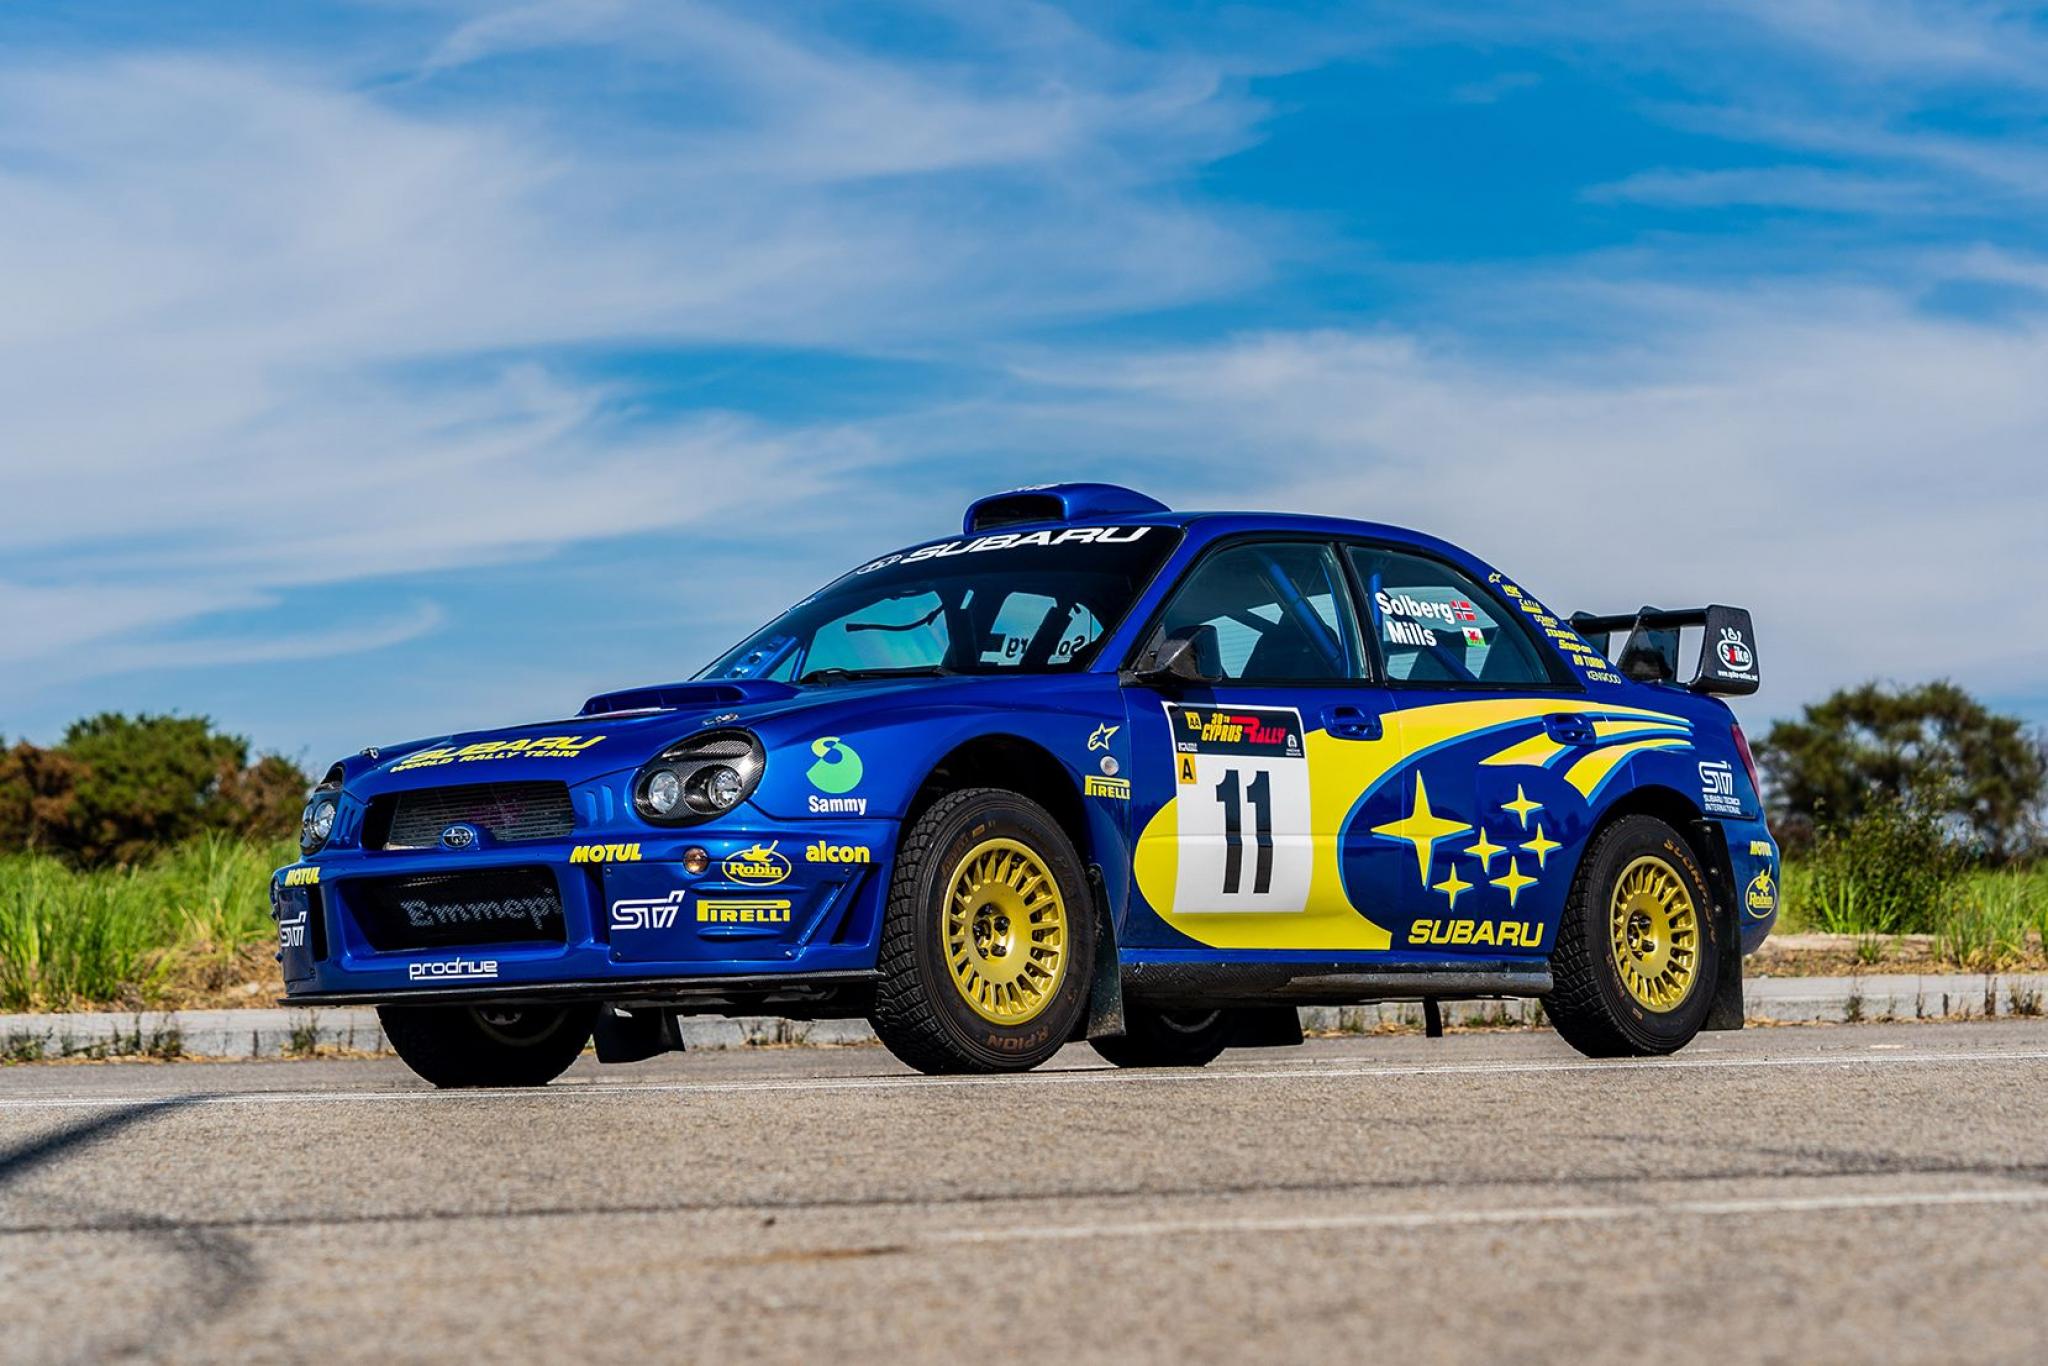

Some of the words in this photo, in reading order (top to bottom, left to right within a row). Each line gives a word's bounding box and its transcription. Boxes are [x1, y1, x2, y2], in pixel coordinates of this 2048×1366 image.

[900, 527, 1151, 565] SUBARU
[1375, 592, 1455, 625] Solberg
[1386, 620, 1437, 647] Mills
[1201, 723, 1243, 742] CYPRUS
[1231, 716, 1286, 744] RALLY
[401, 736, 607, 766] SUBARU
[458, 751, 521, 762] RALLY
[523, 750, 580, 758] TEAM
[1182, 758, 1193, 780] A
[1085, 775, 1131, 799] PIRELLI
[808, 795, 867, 816] Sammy
[1215, 769, 1274, 894] 11
[569, 843, 642, 863] MOTUL
[805, 841, 870, 863] alcon
[284, 867, 320, 887] MOTUL
[729, 862, 783, 878] Robin
[696, 899, 791, 922] PIRELLI
[1408, 919, 1545, 947] SUBARU
[409, 956, 498, 981] prodrive
